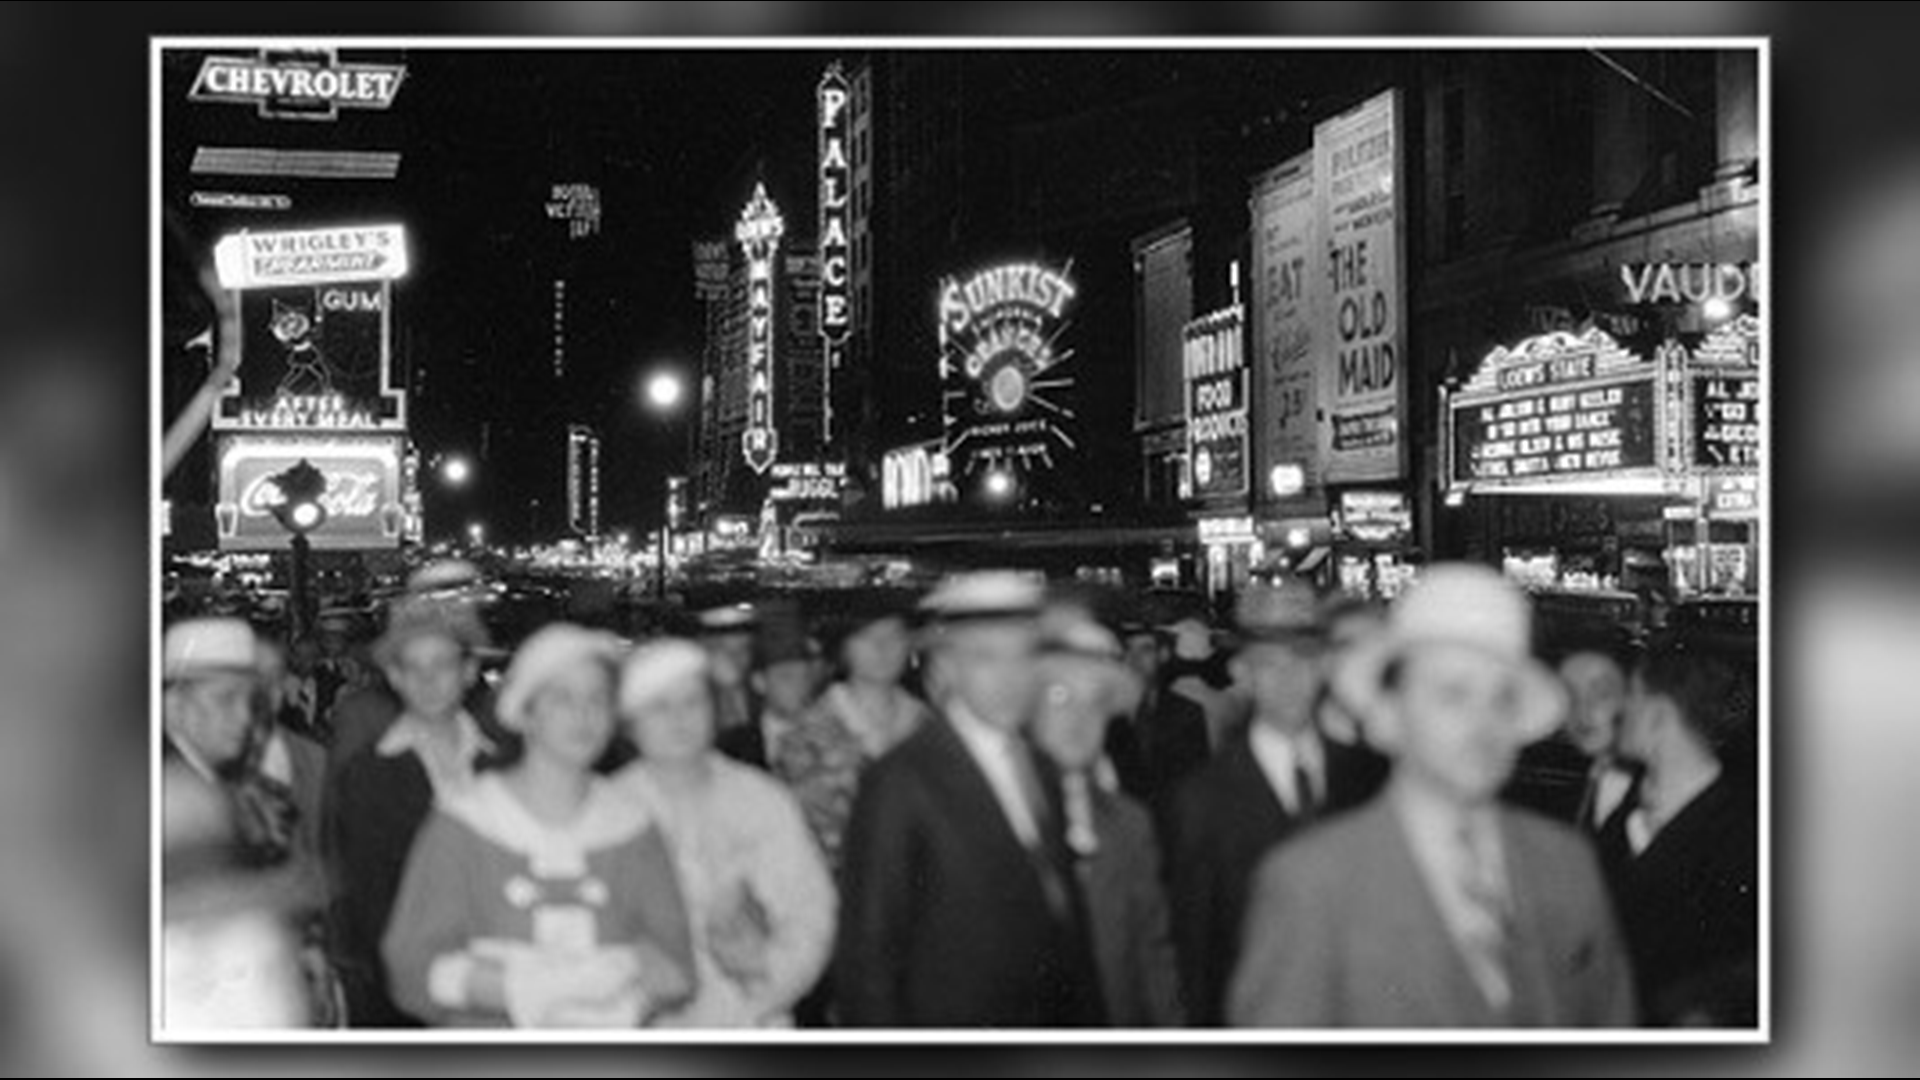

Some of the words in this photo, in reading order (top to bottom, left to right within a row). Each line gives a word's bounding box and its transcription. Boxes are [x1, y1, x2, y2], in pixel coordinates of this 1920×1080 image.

[205, 64, 394, 100] CHEVROLET
[821, 88, 848, 324] PALACE
[252, 231, 391, 253] WRIGLEY'S
[1330, 241, 1367, 293] THE
[323, 289, 384, 311] GUM
[944, 263, 1075, 332] SUNKIST
[1338, 291, 1387, 343] OLD
[751, 260, 768, 451] MAYFAIR
[1338, 343, 1395, 397] MAID
[276, 395, 344, 412] AFTER
[1706, 381, 1730, 399] AL
[240, 412, 308, 429] EVERY
[317, 412, 377, 429] MEAL
